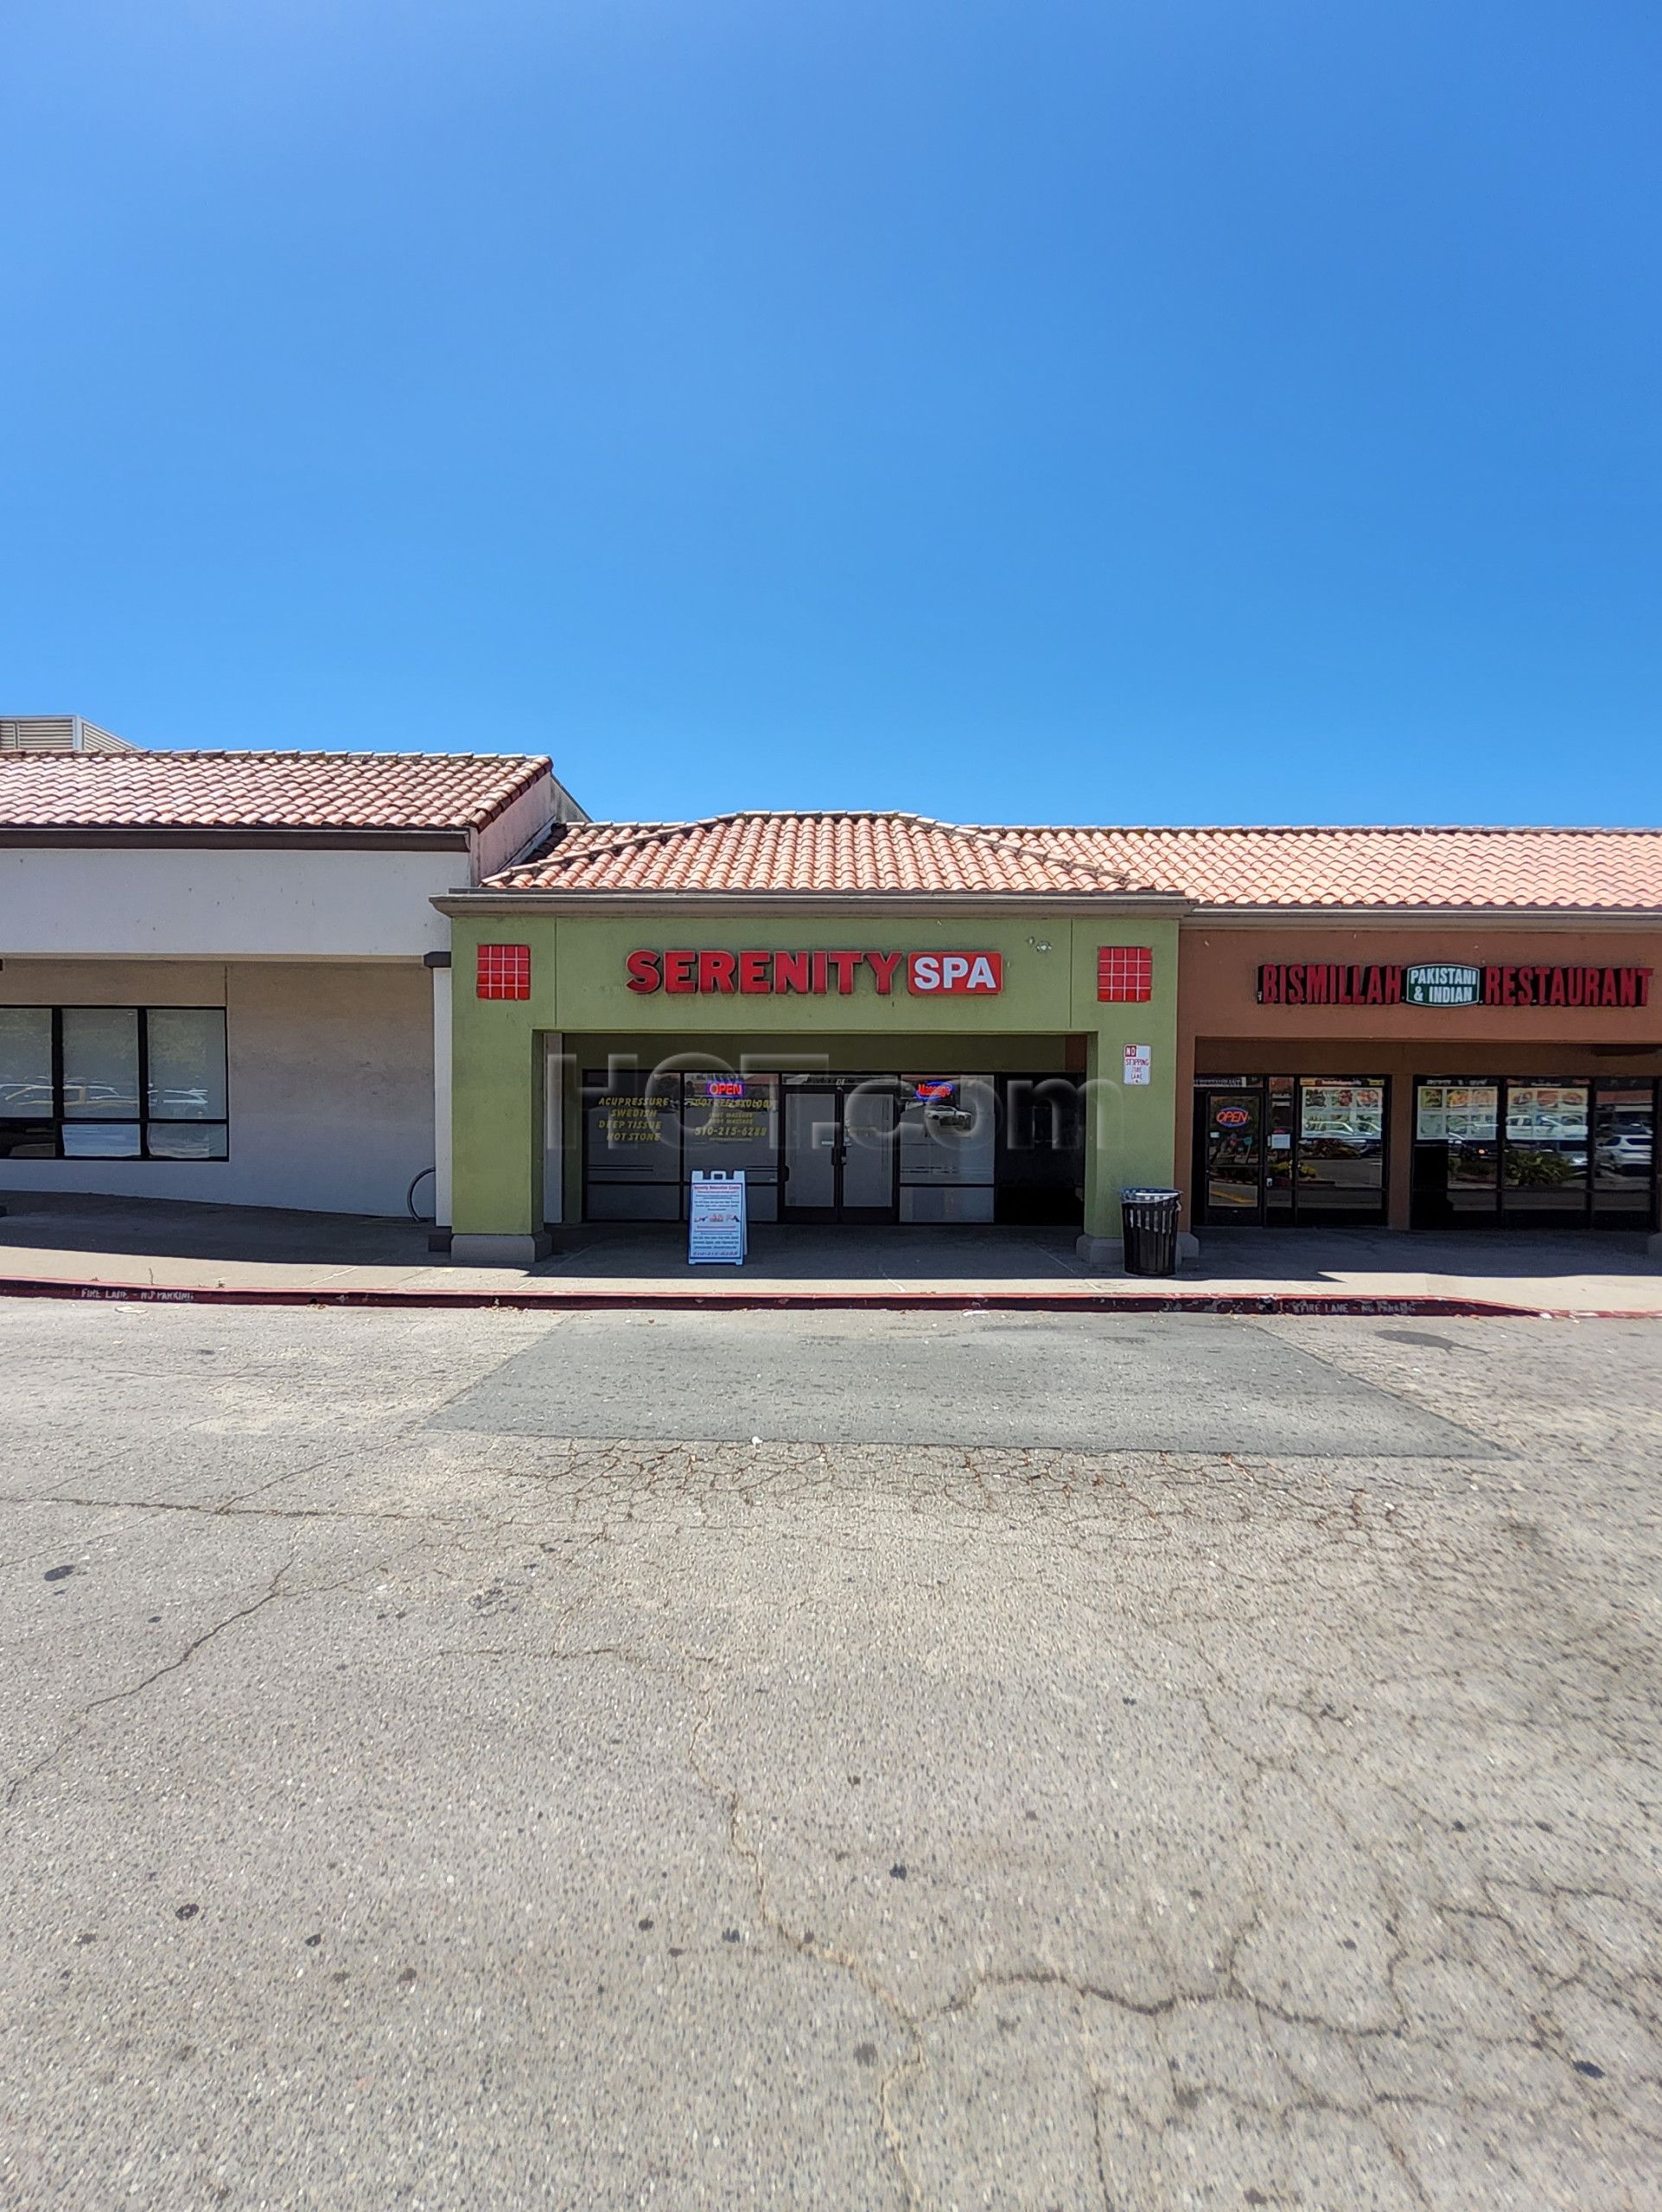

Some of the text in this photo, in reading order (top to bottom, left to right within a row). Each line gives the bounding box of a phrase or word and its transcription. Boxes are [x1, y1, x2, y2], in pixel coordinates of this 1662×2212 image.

[626, 950, 997, 994] SERENITY SPA
[1410, 967, 1477, 985] PAKISTANI
[1259, 963, 1402, 1005] BISMILLAH
[1485, 966, 1654, 1006] RESTAURANT
[1413, 986, 1474, 1002] & INDIAN
[1125, 1046, 1136, 1056] NO
[710, 1084, 742, 1095] OPEN
[598, 1097, 669, 1107] ACUPRESSURE
[610, 1109, 658, 1117] SWEDISH
[1217, 1111, 1248, 1122] OPEN
[599, 1121, 662, 1129] DEEP TISSUE
[607, 1133, 661, 1141] HOT STONE
